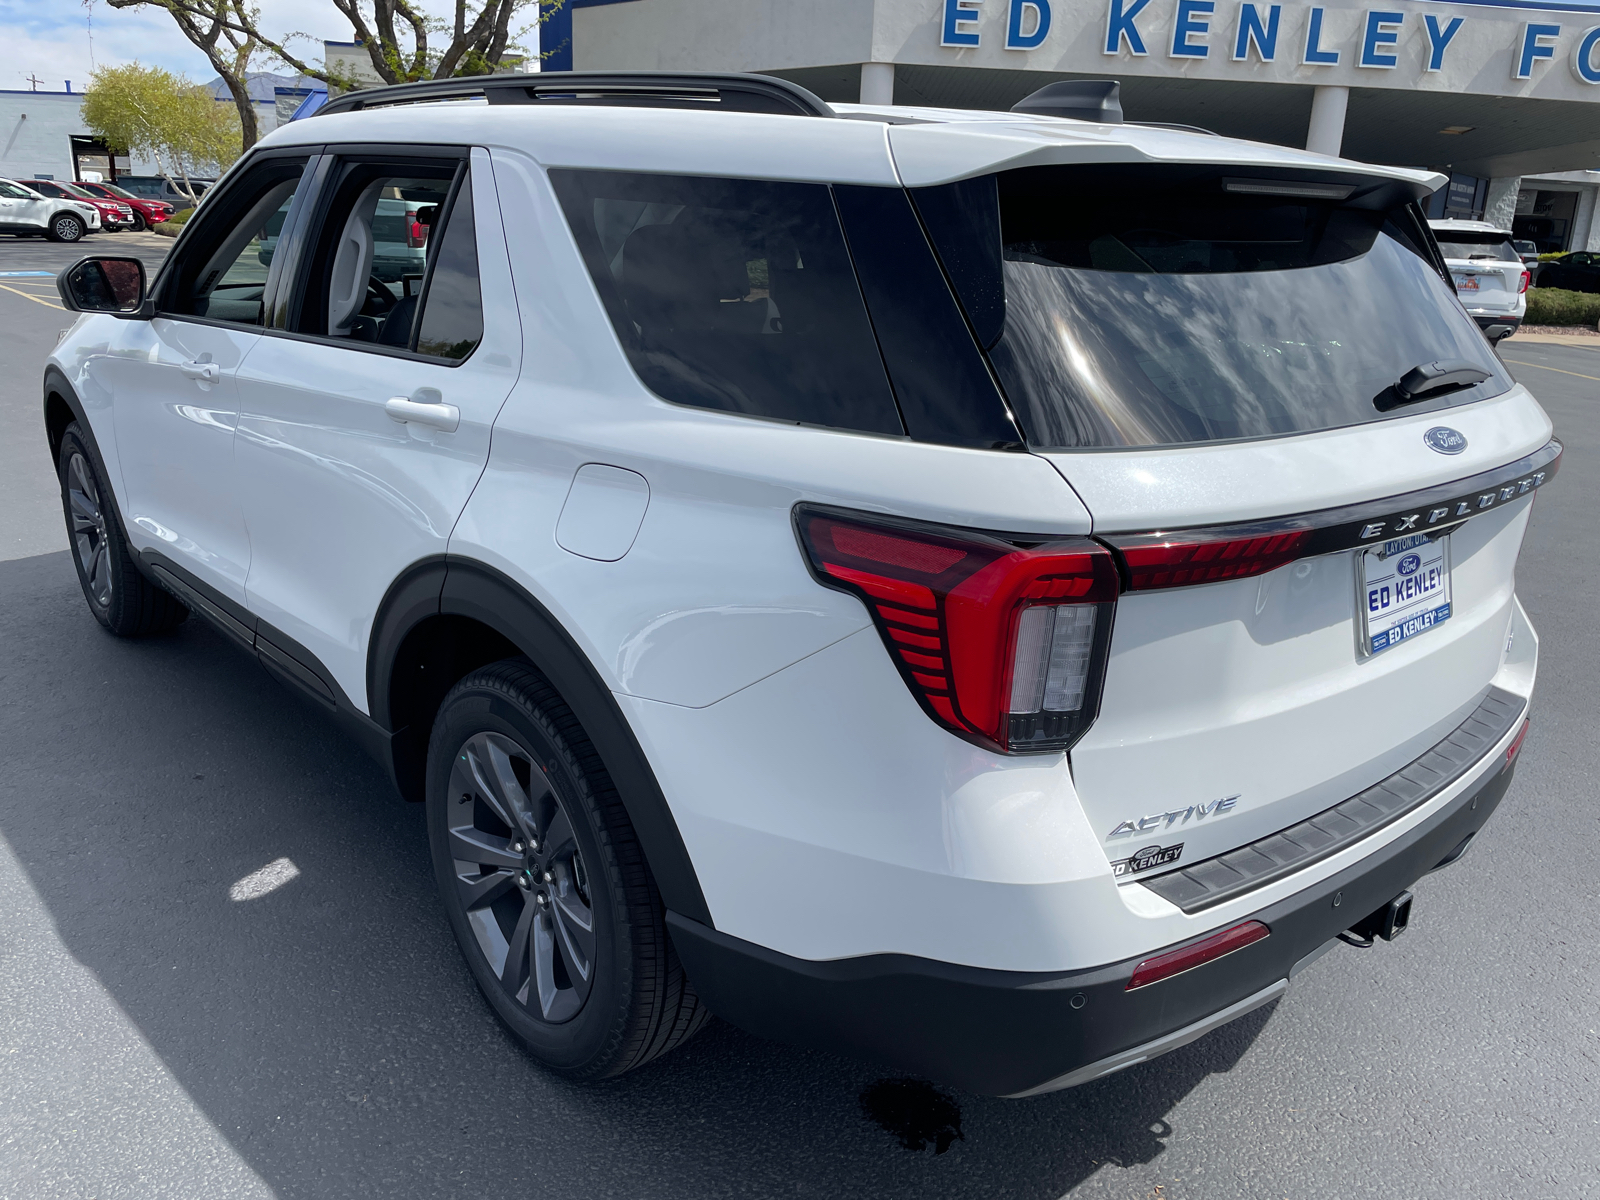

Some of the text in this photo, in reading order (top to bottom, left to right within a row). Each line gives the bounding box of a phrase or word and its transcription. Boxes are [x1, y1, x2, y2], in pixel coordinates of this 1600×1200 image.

[940, 0, 1053, 51] ED
[1103, 0, 1468, 73] KENLEY
[1359, 471, 1546, 539] EXPLORER
[1368, 565, 1442, 612] ED KENLEY
[1388, 626, 1401, 645] ED
[1108, 793, 1242, 837] ACTIVE
[1129, 847, 1183, 872] KENLEY
